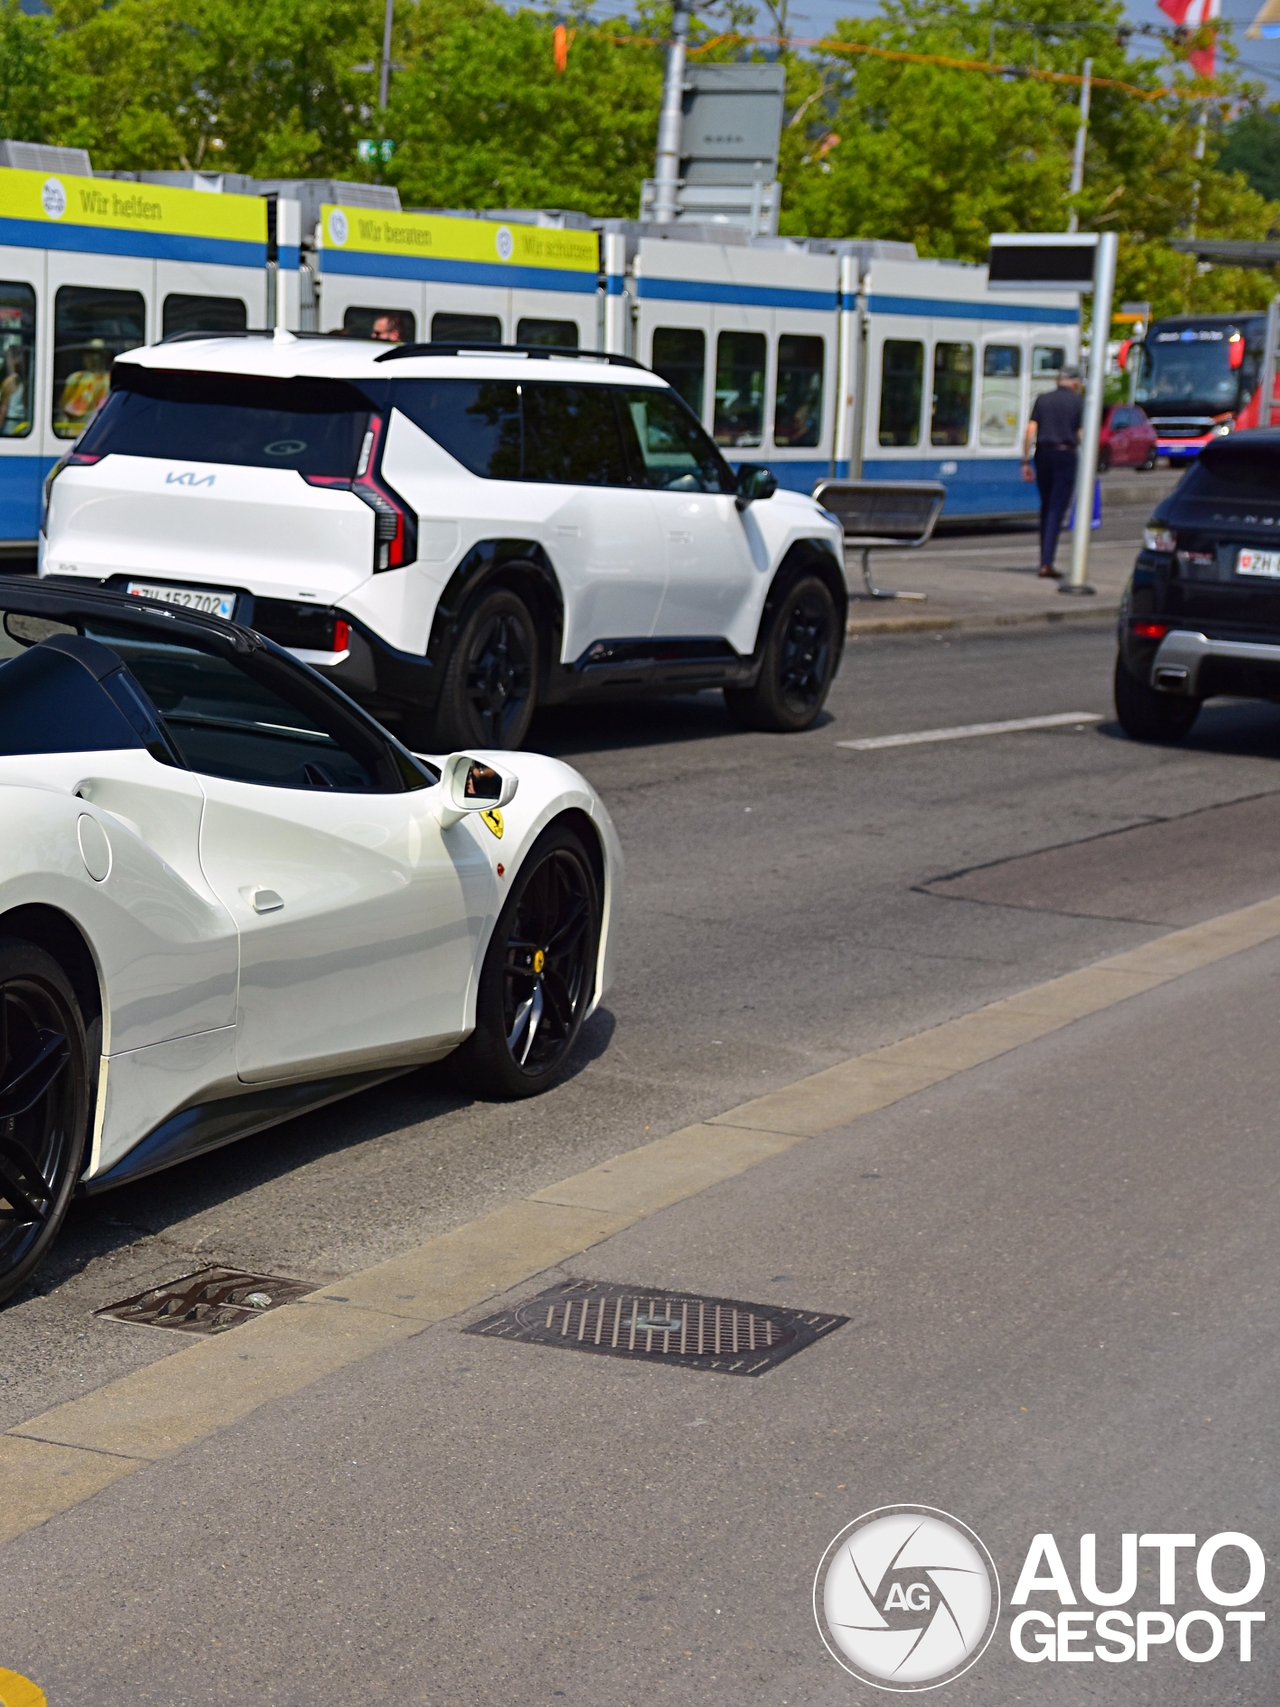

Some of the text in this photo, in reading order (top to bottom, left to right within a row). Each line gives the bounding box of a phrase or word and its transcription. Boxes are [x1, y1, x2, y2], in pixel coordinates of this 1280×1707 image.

[80, 189, 163, 220] Wir helfen
[358, 218, 381, 242] Wir
